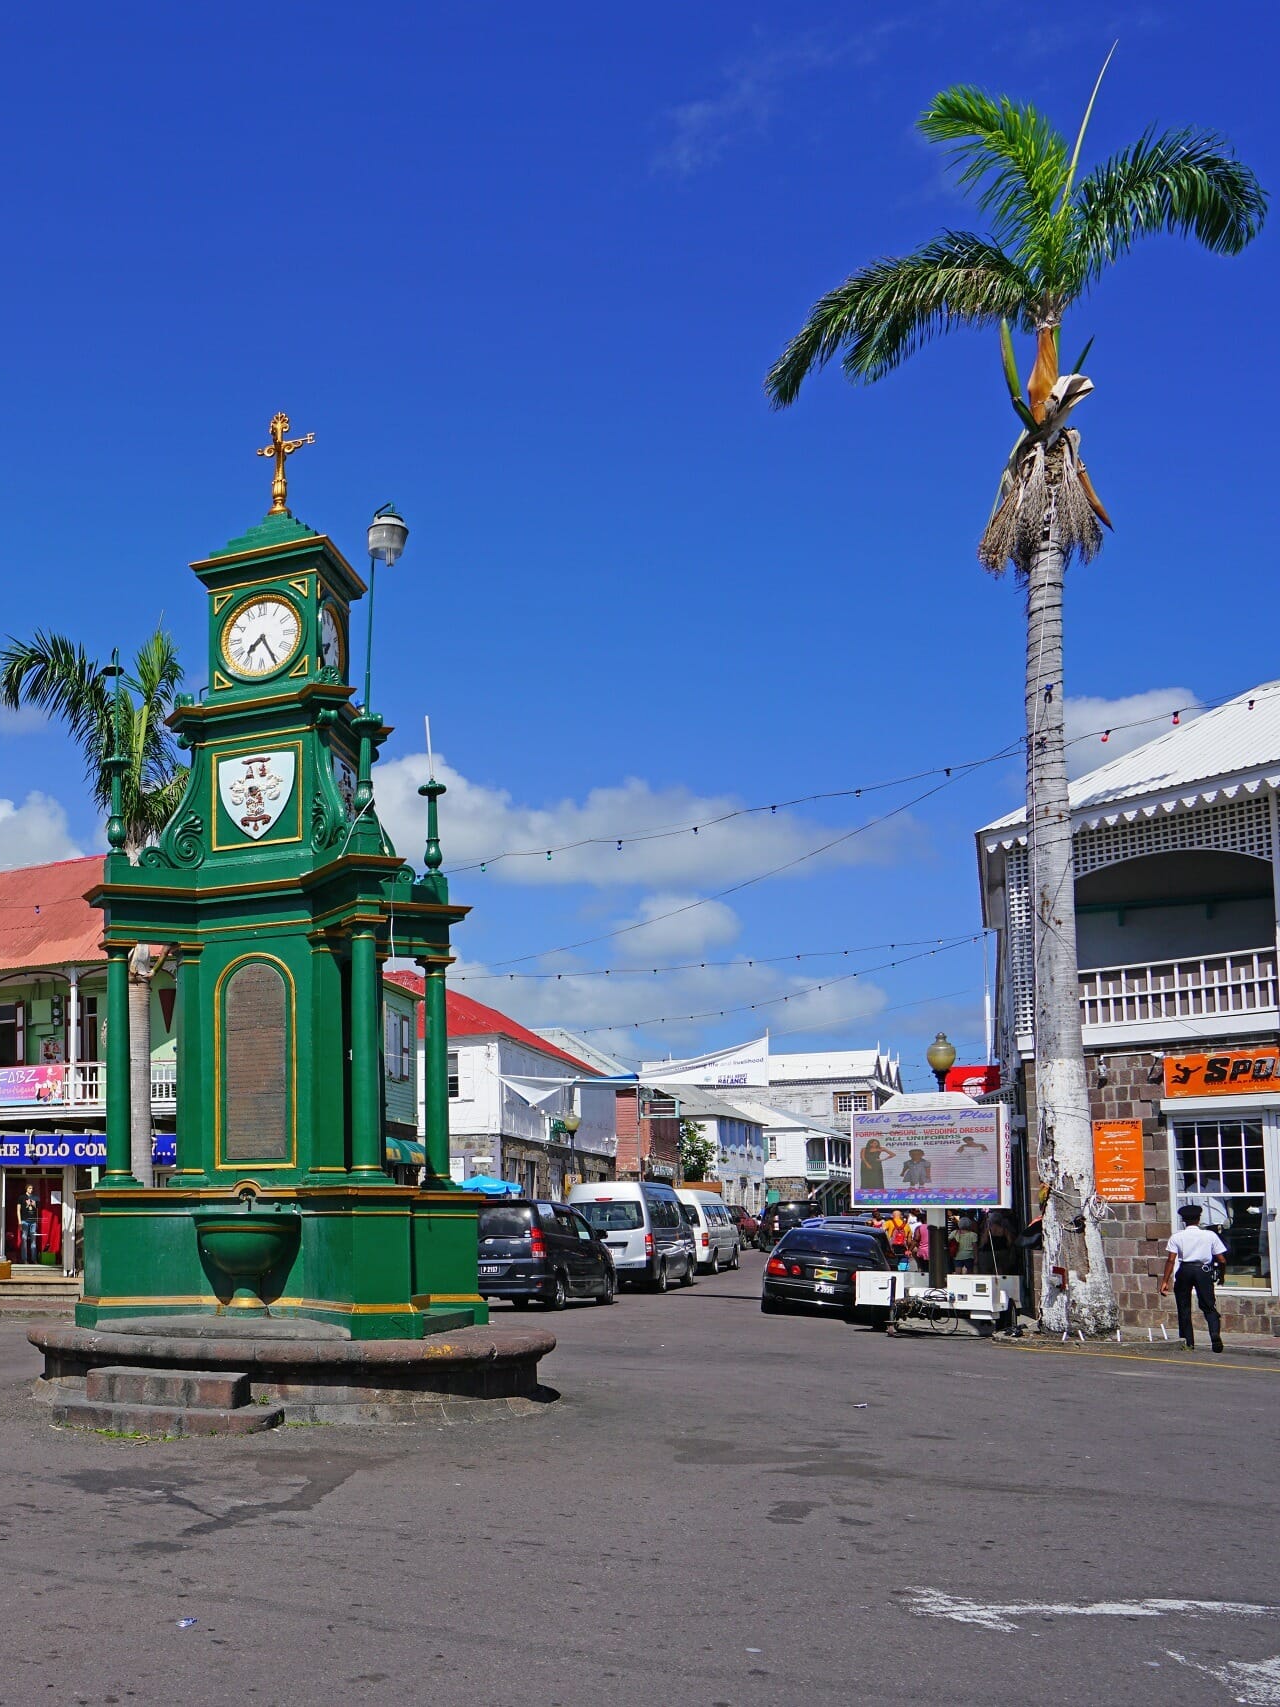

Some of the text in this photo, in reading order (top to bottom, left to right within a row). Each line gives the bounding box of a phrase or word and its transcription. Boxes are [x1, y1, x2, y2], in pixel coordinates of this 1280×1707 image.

[1204, 1057, 1280, 1084] SPO
[856, 1109, 994, 1125] Val's Designs Plus
[855, 1130, 884, 1138] FORMAL
[24, 1143, 70, 1157] POLO
